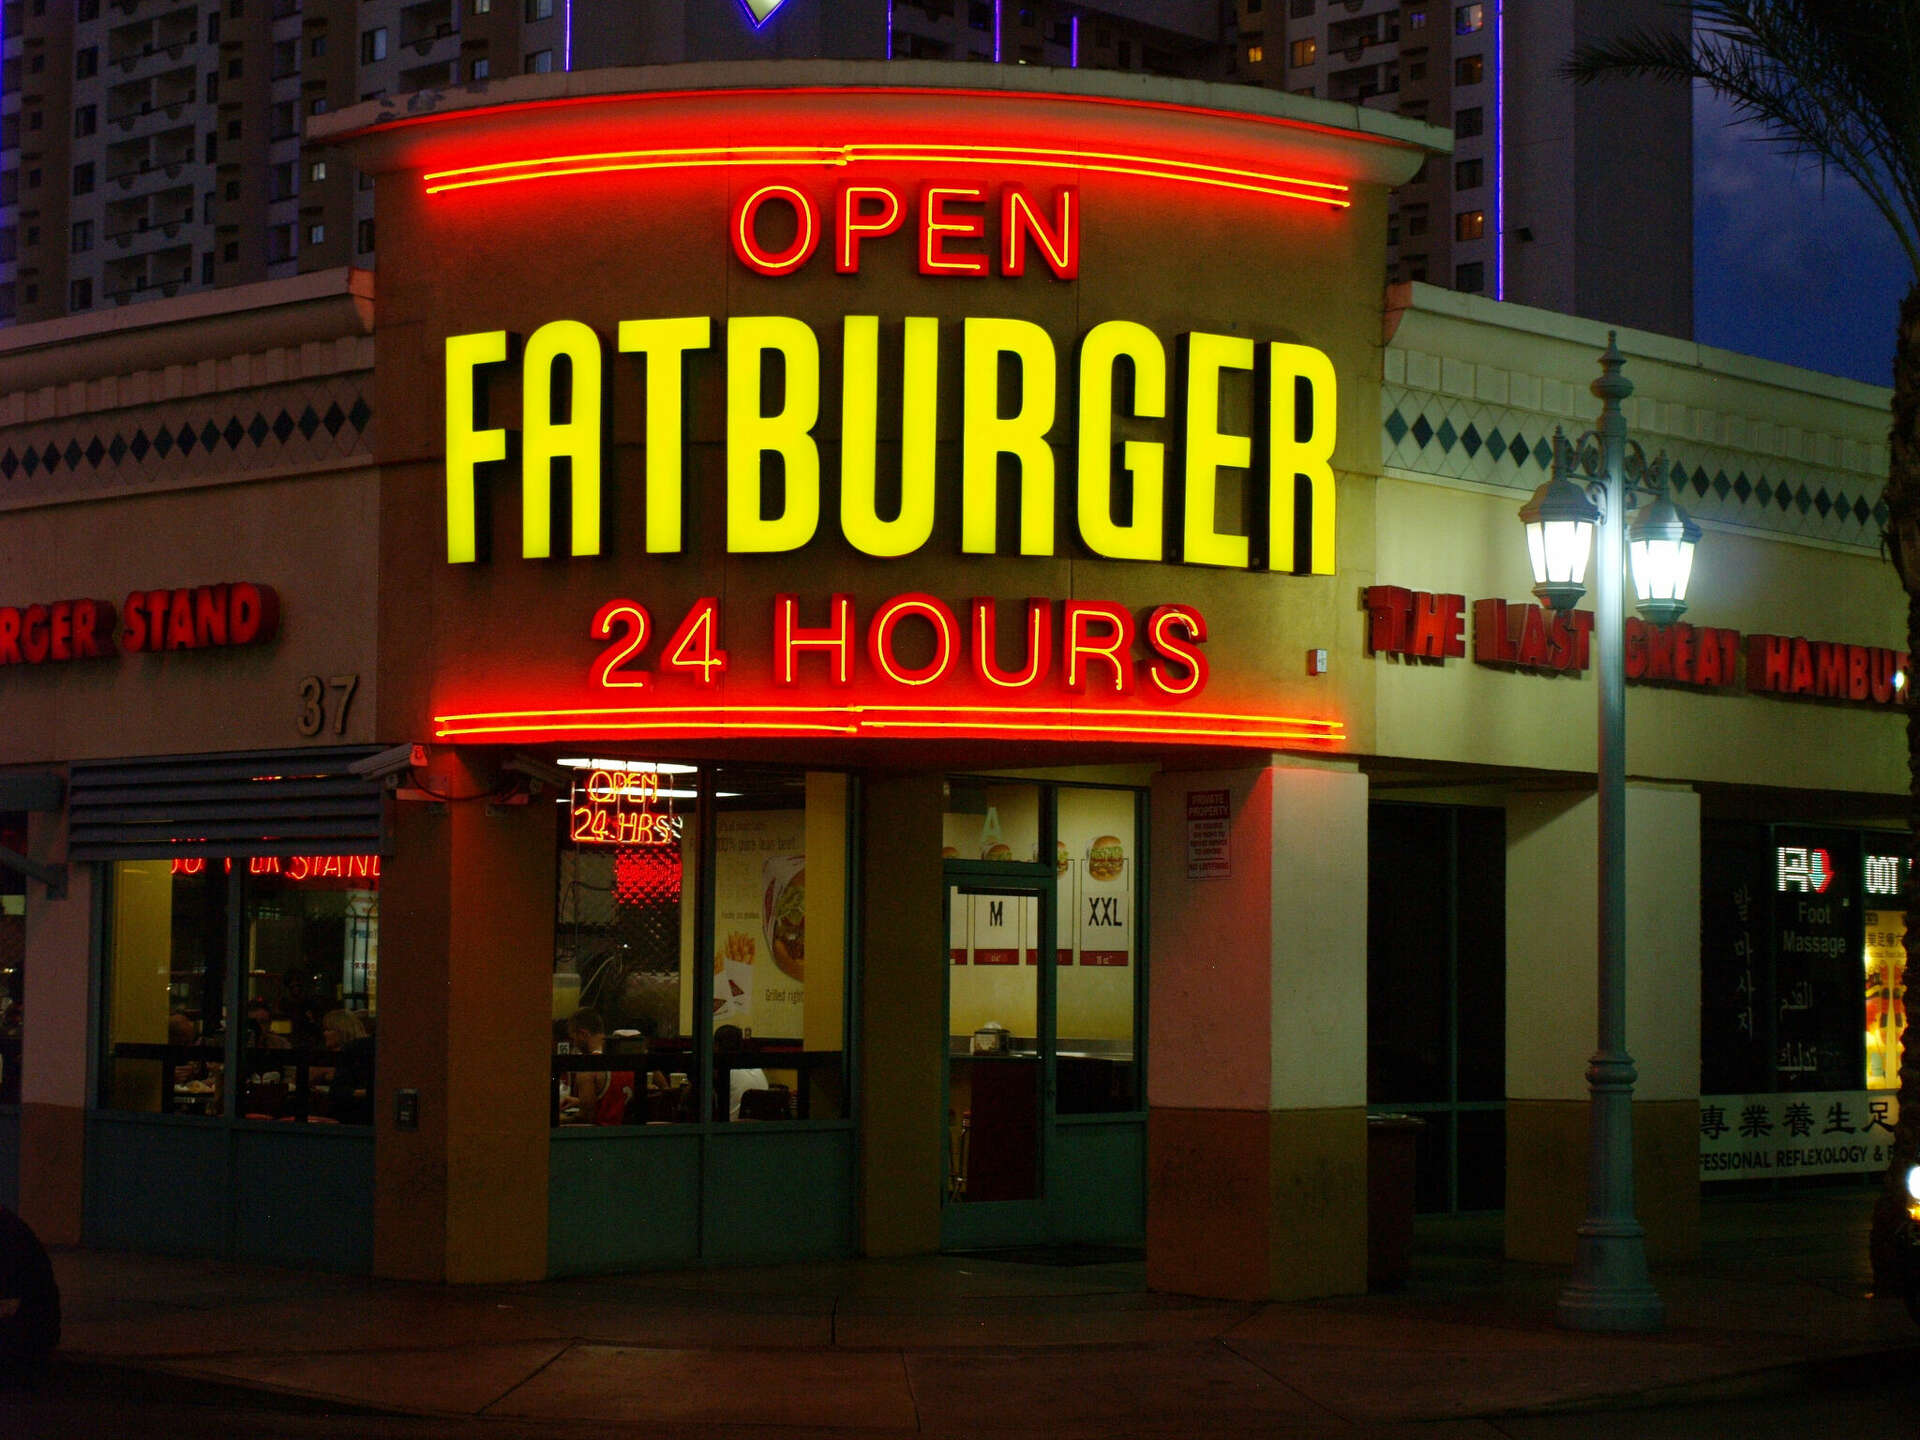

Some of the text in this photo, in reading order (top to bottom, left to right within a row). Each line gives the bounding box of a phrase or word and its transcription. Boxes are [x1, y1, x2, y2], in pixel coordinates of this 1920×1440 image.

[731, 178, 1080, 281] OPEN
[444, 315, 1337, 575] FATBURGER
[122, 581, 276, 654] STAND
[1366, 585, 1465, 658] THE
[1476, 598, 1594, 671] LAST
[590, 592, 1209, 701] 24 HOURS
[299, 672, 360, 738] 37
[587, 770, 659, 803] OPEN
[574, 807, 670, 843] 24 HRS
[989, 900, 1004, 927] M
[1087, 897, 1123, 927] XXL
[1798, 901, 1833, 925] Foot
[1783, 930, 1848, 959] Massage
[1700, 1101, 1895, 1140] 專業養生足
[1776, 1145, 1868, 1169] REFLEXOLOGY
[1873, 1144, 1884, 1162] &
